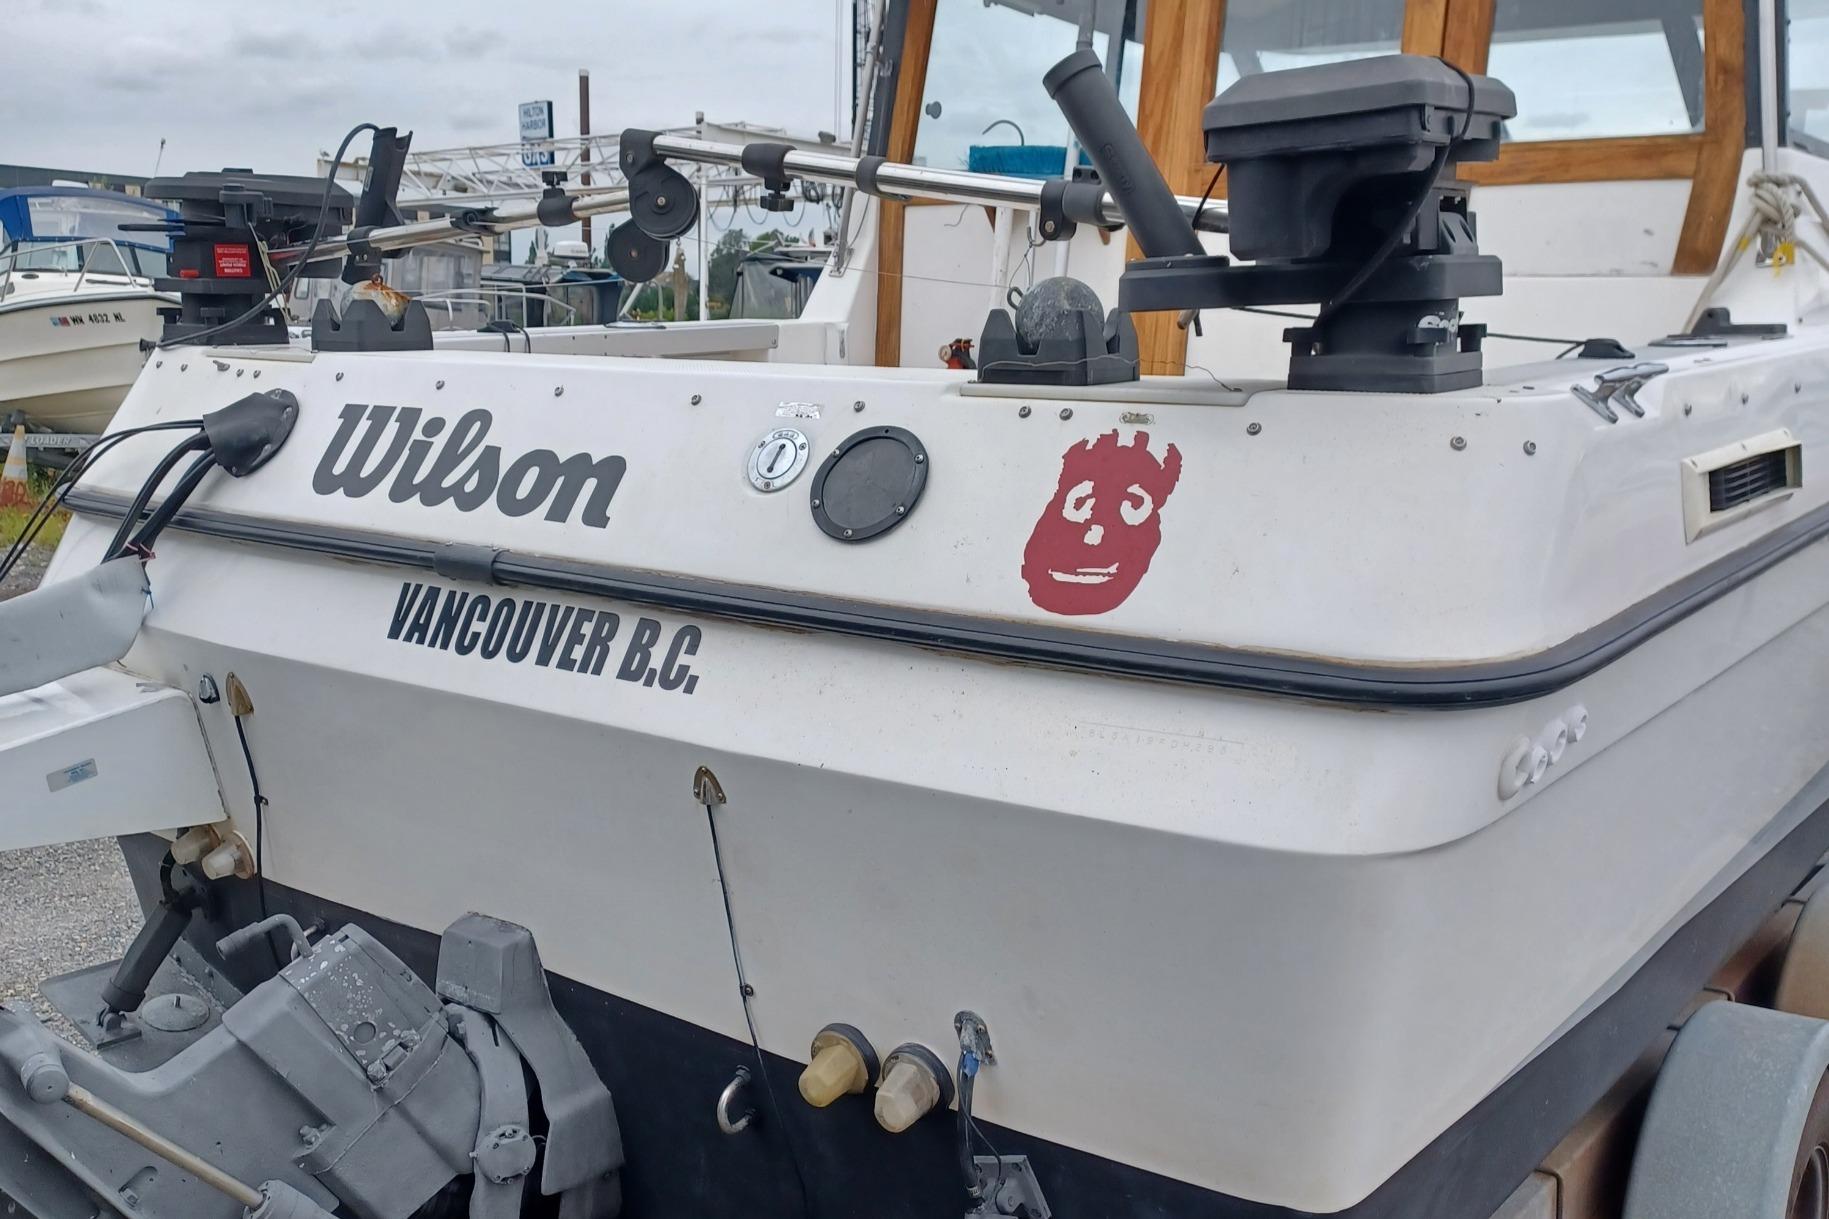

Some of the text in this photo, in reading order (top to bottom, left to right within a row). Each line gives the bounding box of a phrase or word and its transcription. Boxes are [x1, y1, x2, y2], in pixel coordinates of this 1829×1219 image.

[312, 403, 627, 529] Wilson
[387, 572, 702, 695] VANCOUVER B.C.
